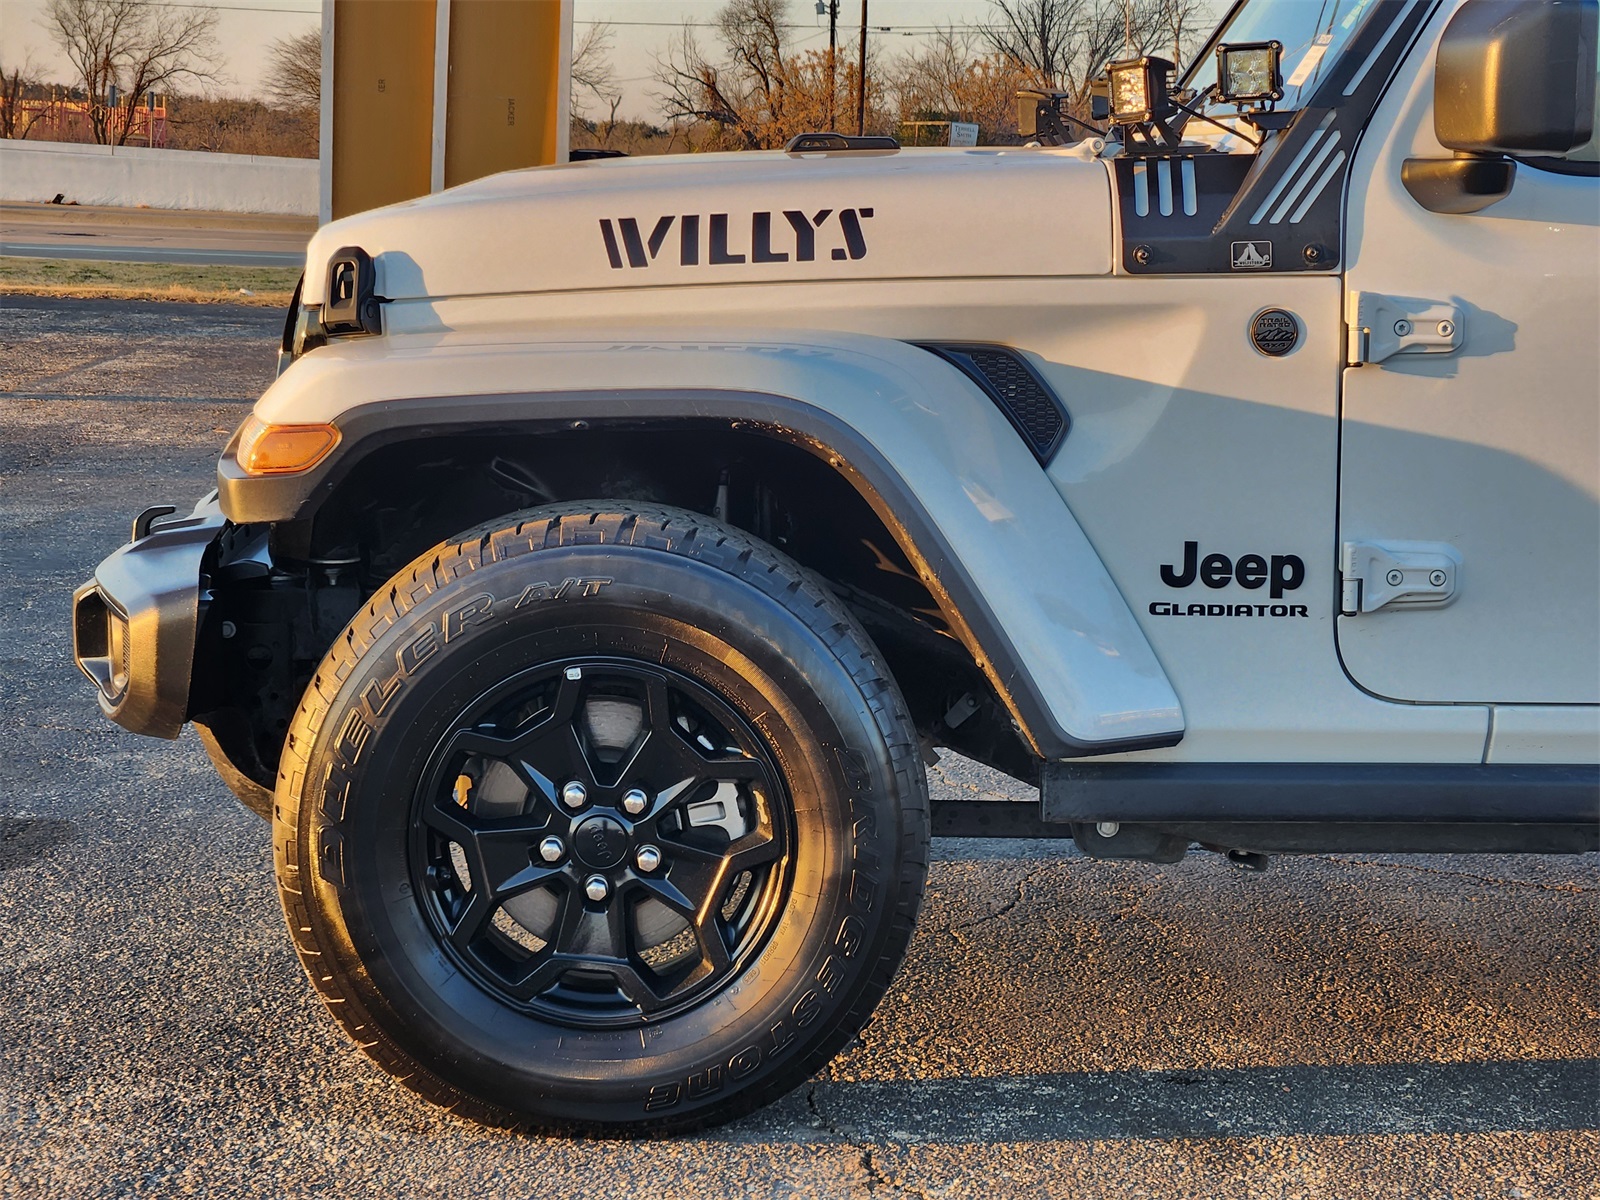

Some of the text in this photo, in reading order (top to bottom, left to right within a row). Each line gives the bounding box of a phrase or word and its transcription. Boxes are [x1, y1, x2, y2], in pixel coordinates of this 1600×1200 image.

[599, 208, 874, 269] WILLYS
[1160, 541, 1305, 599] Jeep
[1149, 602, 1309, 617] GLADIATOR
[316, 592, 496, 887] DUELER
[645, 746, 881, 1111] BRIDGESTONE
